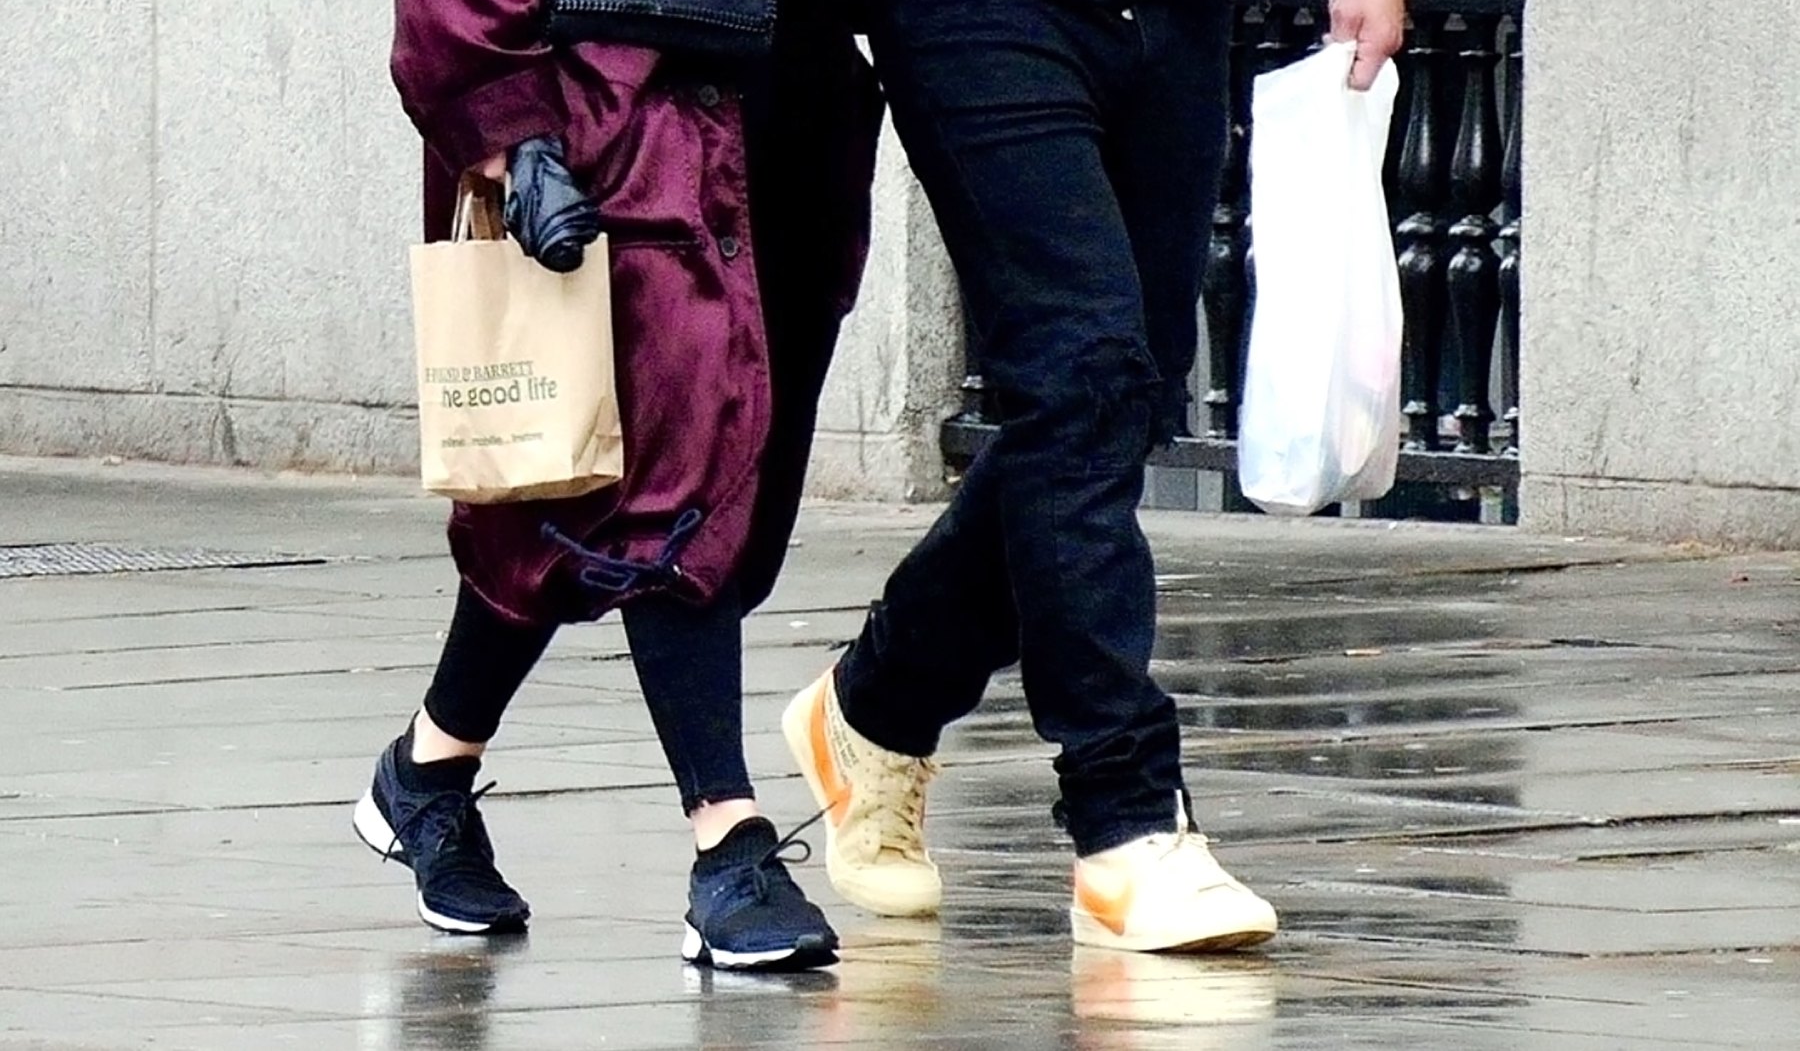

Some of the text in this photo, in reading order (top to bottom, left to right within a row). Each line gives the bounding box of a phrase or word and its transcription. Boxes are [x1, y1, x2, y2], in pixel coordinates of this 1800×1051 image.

[473, 361, 534, 381] BARRETT
[468, 380, 521, 407] good
[527, 377, 557, 401] life
